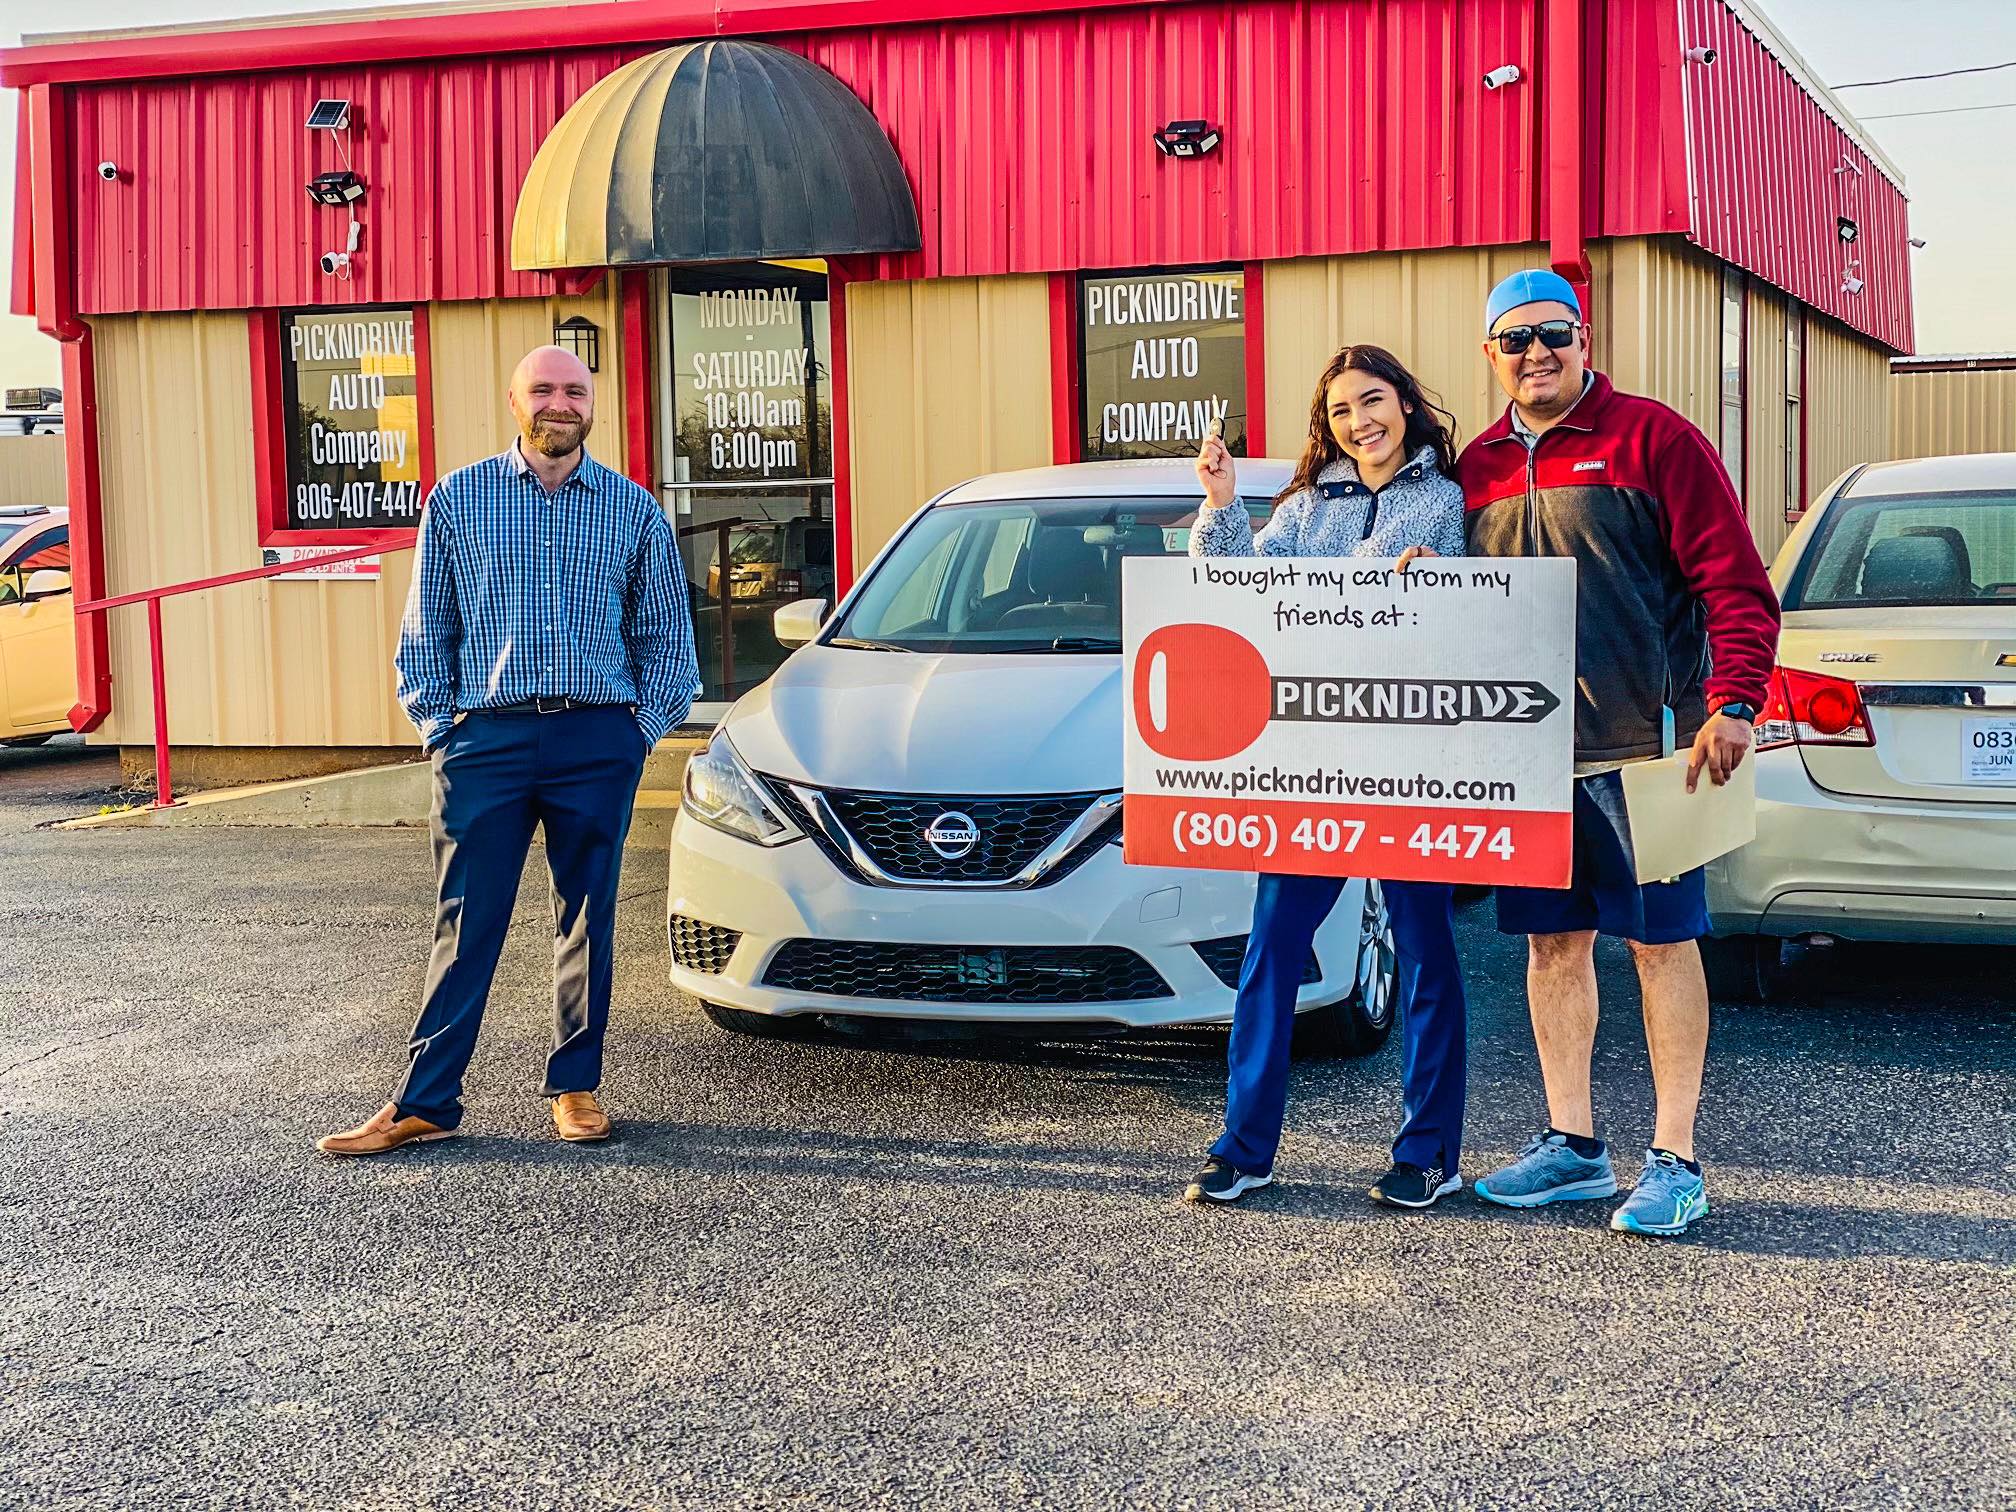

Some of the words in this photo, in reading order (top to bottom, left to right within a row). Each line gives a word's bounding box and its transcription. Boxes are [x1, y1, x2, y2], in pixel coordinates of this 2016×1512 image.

[699, 287, 798, 328] MONDAY
[1088, 279, 1239, 326] PICKNDRIVE
[290, 320, 415, 361] PICKNDRIVE
[1131, 336, 1199, 379] AUTO
[692, 348, 809, 390] SATURDAY
[328, 374, 385, 411] AUTO
[704, 390, 801, 429] 10:00am
[310, 422, 407, 470] Company
[711, 431, 797, 476] 6:00pm
[331, 564, 356, 573] UNITS
[1193, 567, 1198, 584] I
[1206, 563, 1301, 594] bought
[1307, 570, 1344, 596] my
[1352, 569, 1394, 588] car
[1400, 561, 1463, 592] from
[1472, 571, 1511, 597] my
[1274, 600, 1364, 631] friends
[1371, 604, 1404, 627] at
[1276, 681, 1545, 720] PICKNDRIVE
[1973, 731, 2016, 748] 083
[1988, 755, 2013, 765] JUN
[1155, 766, 1516, 802] www.pickndriveauto.com
[930, 832, 973, 840] NISSAN
[1172, 810, 1278, 856] (806)
[1290, 817, 1367, 852] 407
[1408, 823, 1516, 860] 4474
